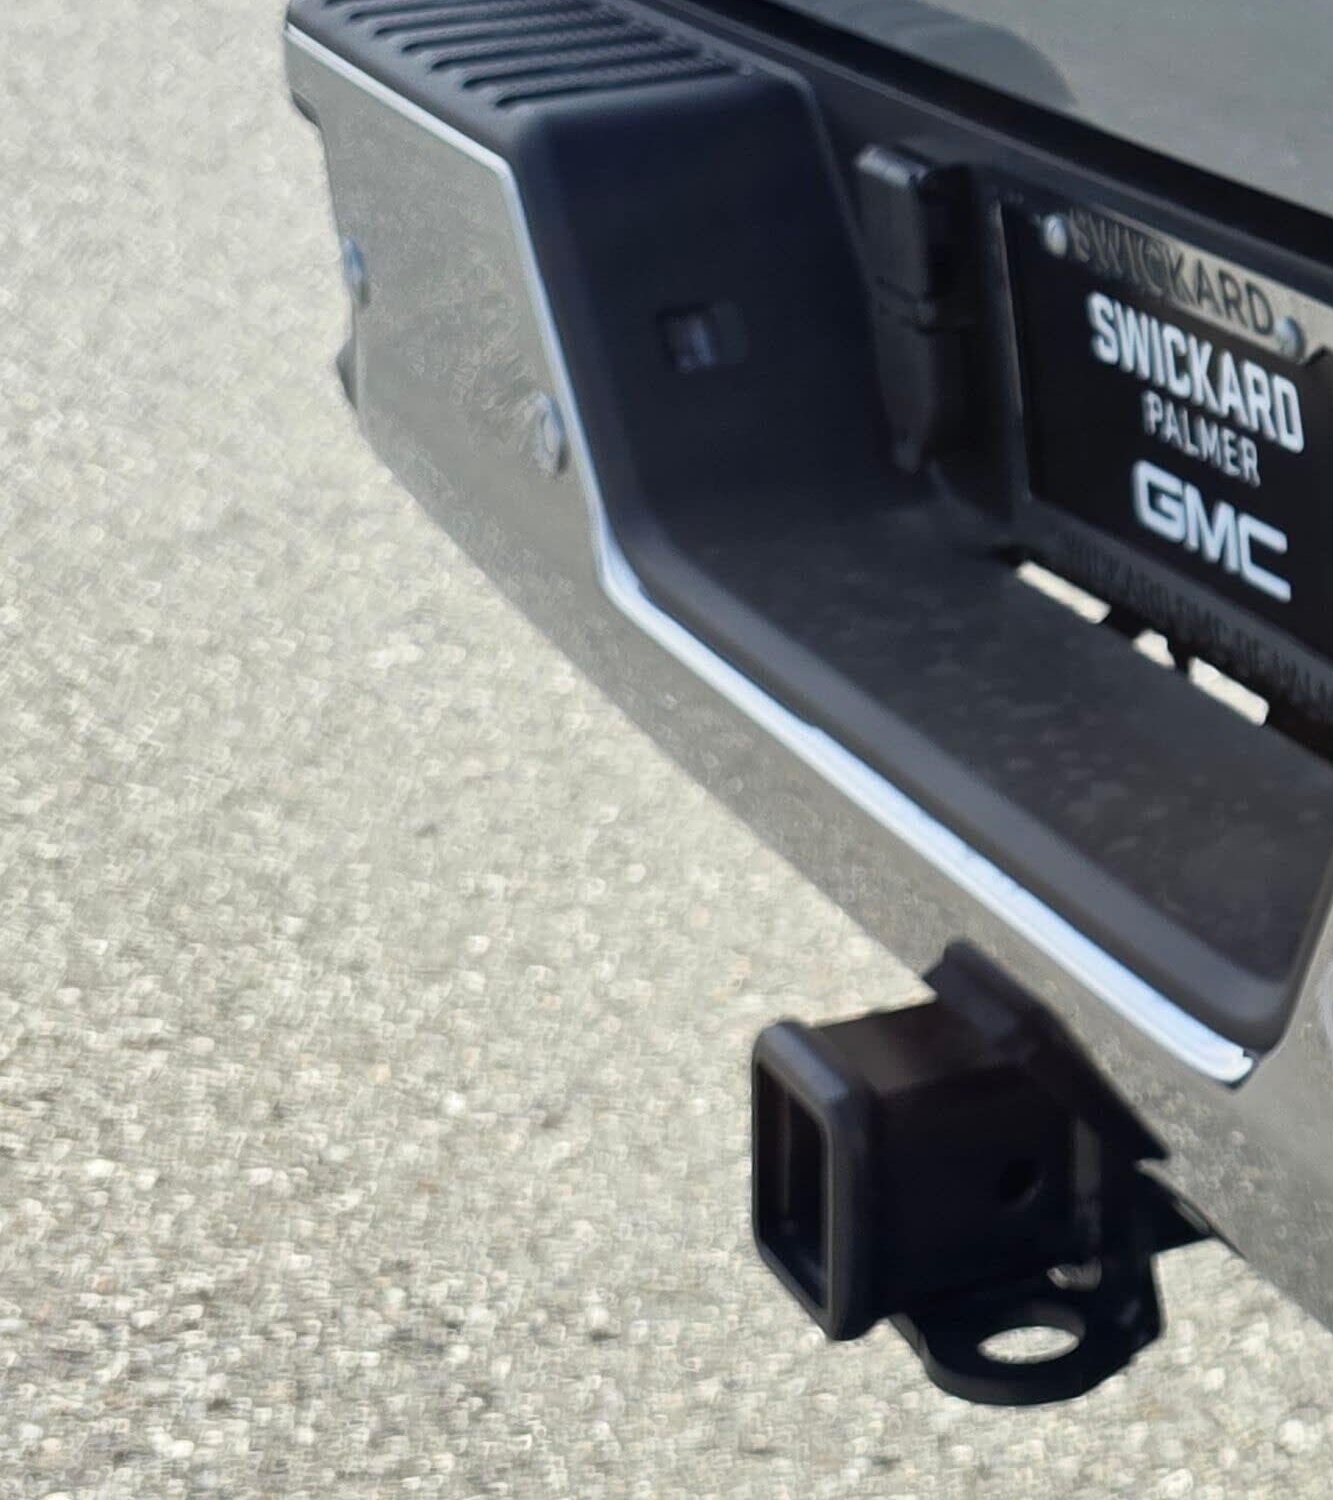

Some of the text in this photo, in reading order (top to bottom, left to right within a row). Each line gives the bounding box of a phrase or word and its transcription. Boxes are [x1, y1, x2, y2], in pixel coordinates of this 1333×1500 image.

[1067, 208, 1274, 336] SWICKARD
[1087, 292, 1304, 453] SWICKARD
[1142, 391, 1261, 487] PALMER
[1133, 459, 1292, 602] GMC
